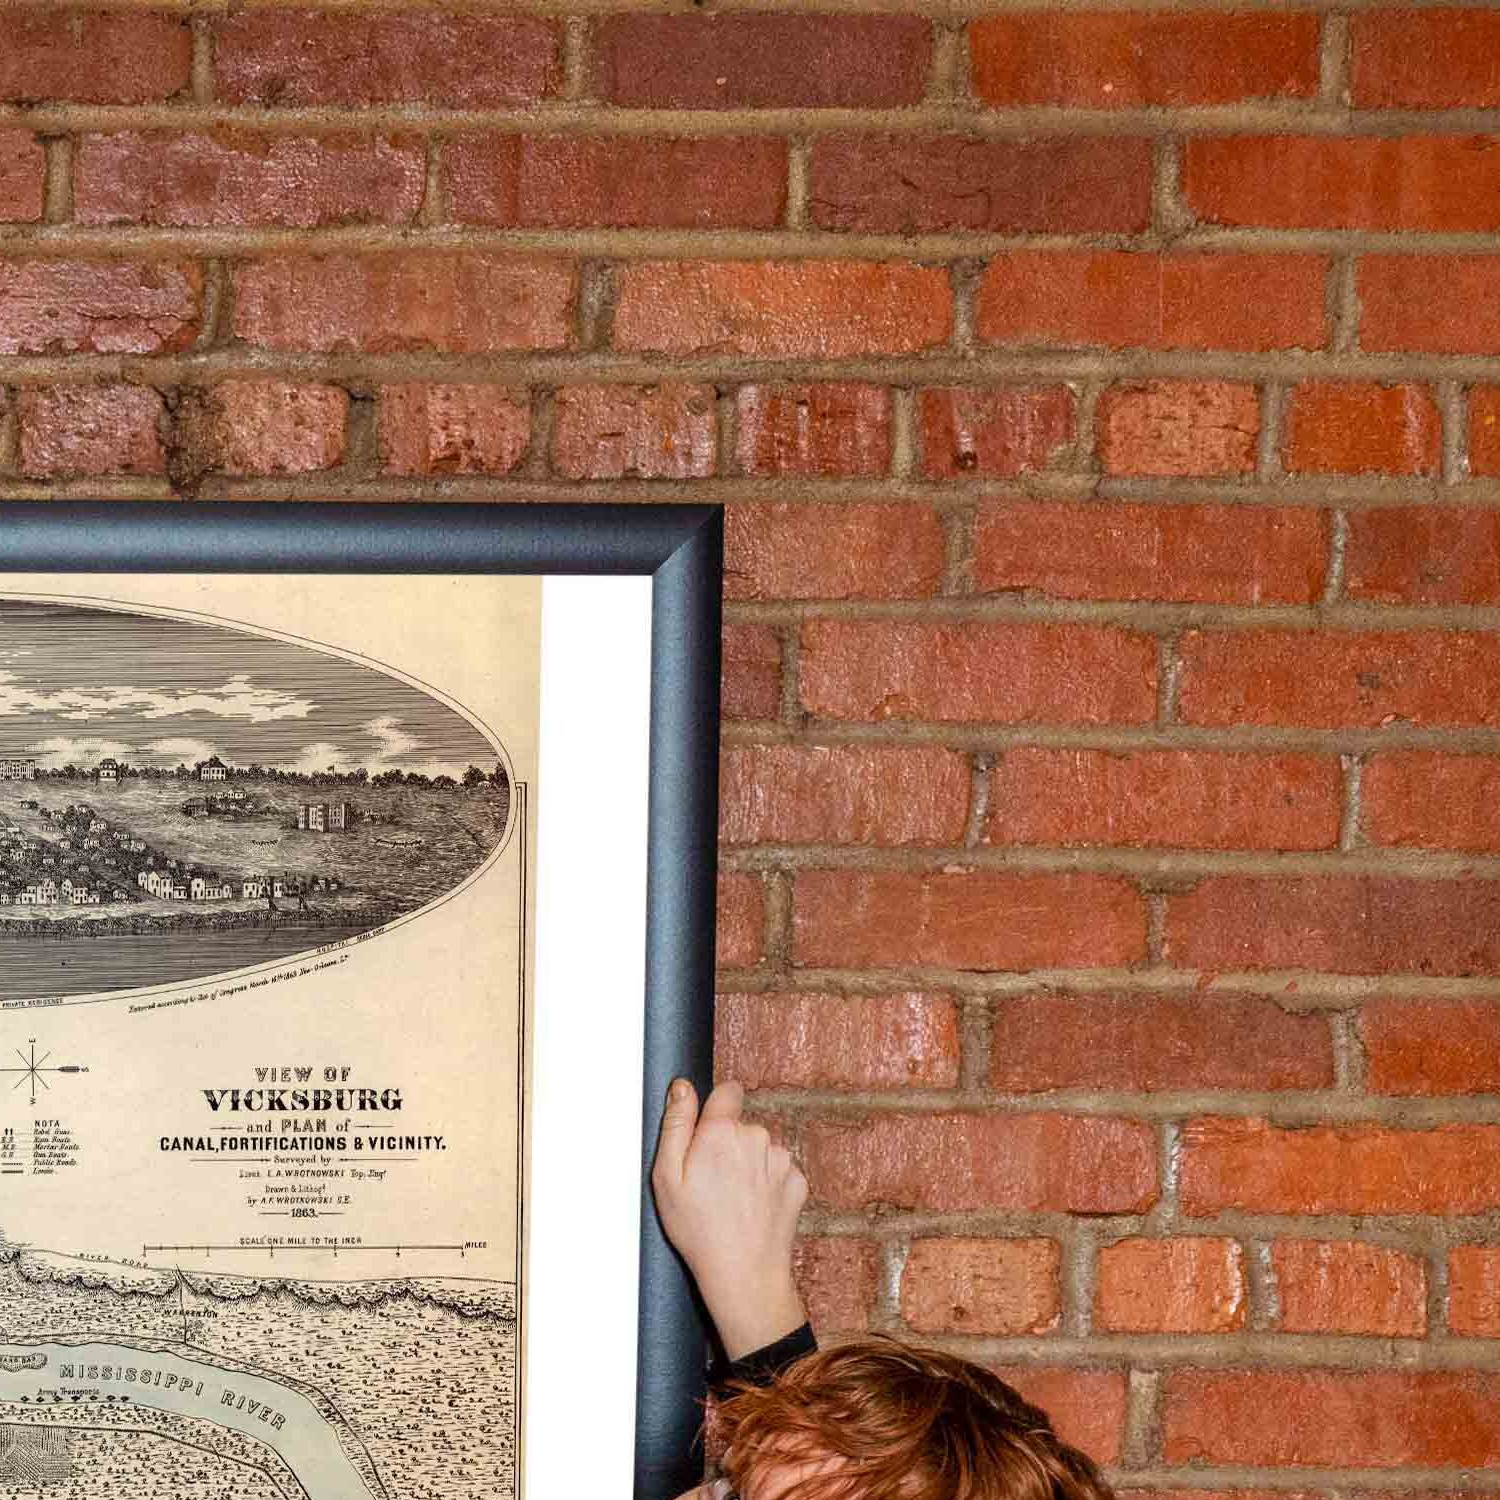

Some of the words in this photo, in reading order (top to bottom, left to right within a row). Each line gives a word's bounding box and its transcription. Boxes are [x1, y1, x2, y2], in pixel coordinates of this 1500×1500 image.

[254, 1067, 312, 1082] VIEW
[324, 1067, 351, 1082] OF
[200, 1088, 404, 1111] VICKSBURG
[246, 1120, 272, 1132] and
[281, 1119, 327, 1132] PLAN
[336, 1119, 352, 1132] of
[354, 1137, 364, 1150] &
[369, 1136, 447, 1151] VICINITY.
[273, 1155, 317, 1165] Surveyed
[320, 1155, 332, 1166] by
[240, 1237, 264, 1245] SCALE
[268, 1237, 283, 1245] ONE
[287, 1237, 307, 1245] MILE
[311, 1237, 321, 1245] TO
[59, 1363, 204, 1395] MISSISSIPPI
[220, 1389, 286, 1430] RIVER
